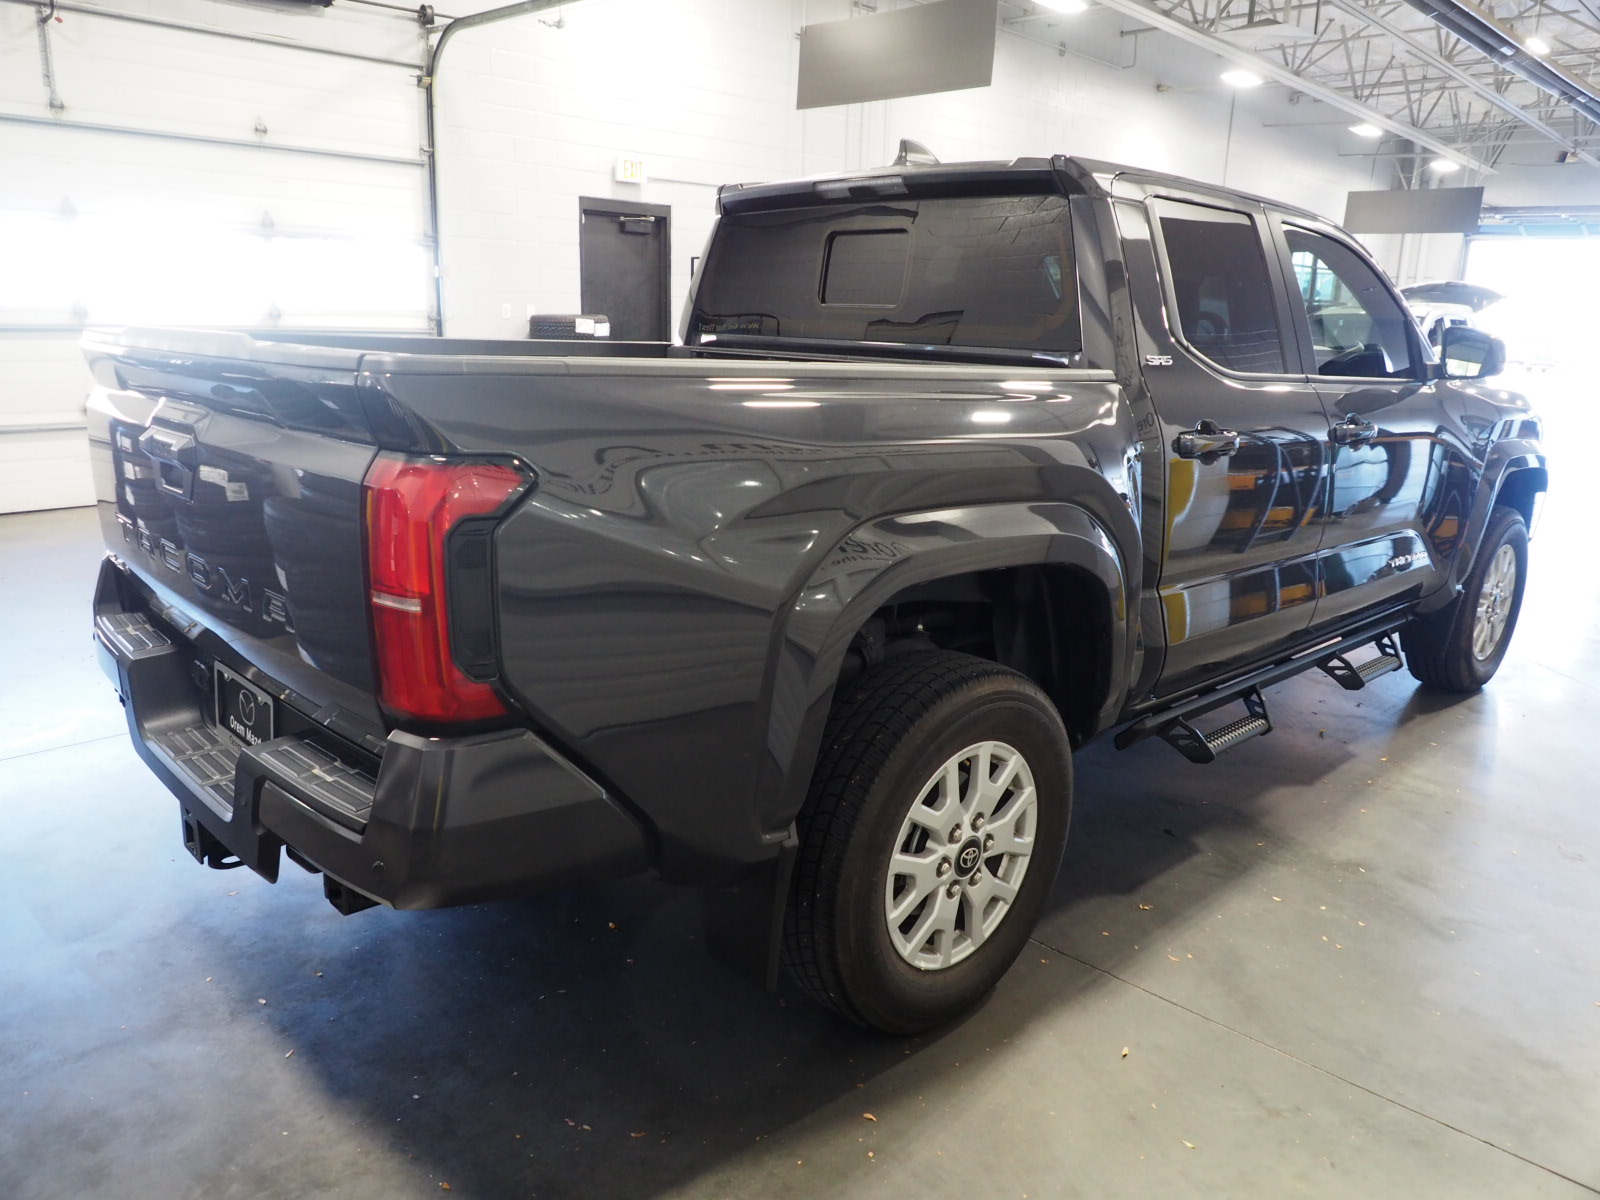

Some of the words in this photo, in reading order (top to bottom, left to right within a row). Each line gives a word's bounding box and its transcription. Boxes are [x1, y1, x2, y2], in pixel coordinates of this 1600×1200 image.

[623, 159, 643, 179] EXIT
[1146, 355, 1173, 366] SR5
[115, 512, 296, 634] TACOMA
[230, 715, 246, 738] Orem
